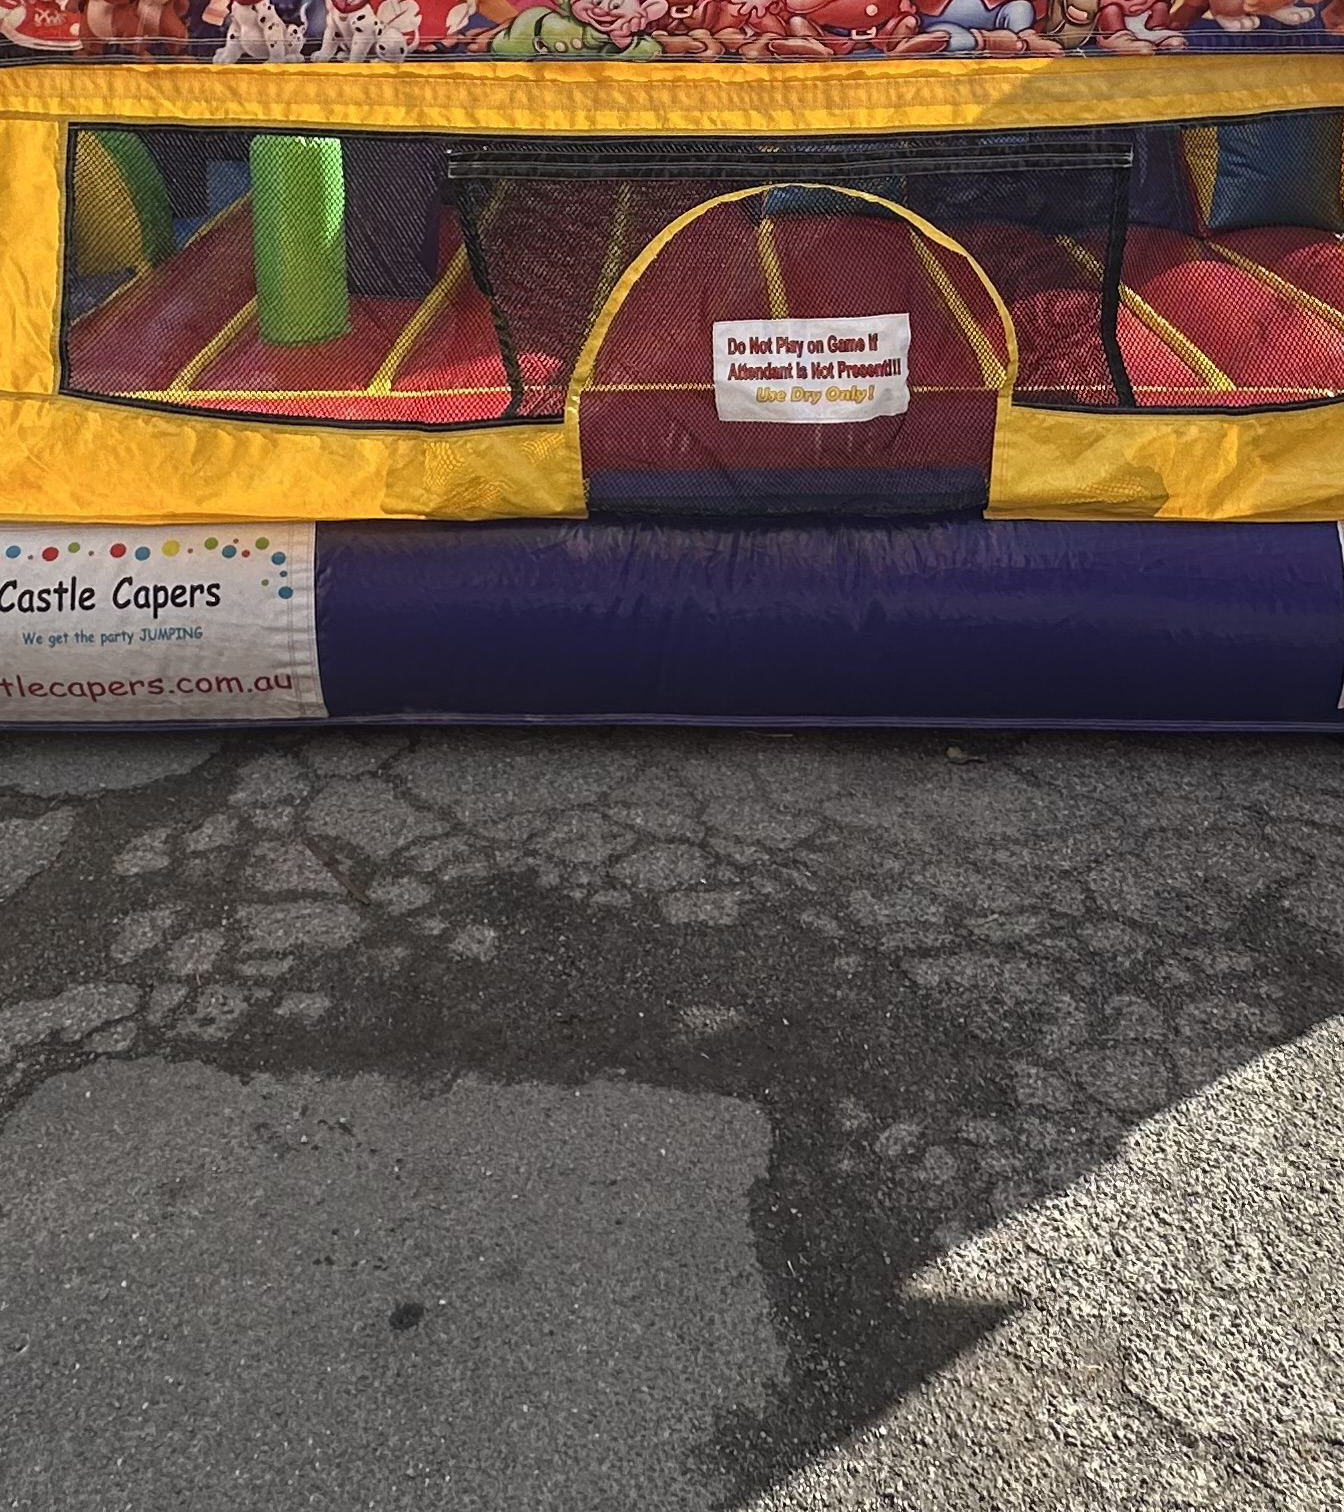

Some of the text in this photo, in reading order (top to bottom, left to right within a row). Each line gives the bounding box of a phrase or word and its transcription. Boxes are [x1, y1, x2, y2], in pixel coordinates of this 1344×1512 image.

[727, 337, 746, 356] Do
[749, 337, 773, 355] Not
[775, 336, 804, 359] Play
[807, 339, 824, 355] on
[827, 335, 865, 354] Game
[727, 358, 902, 381] Attendant Is Not Present!!!
[756, 385, 876, 405] Use Dry Only!
[112, 576, 222, 619] Capers
[22, 626, 204, 648] We get the party JUMPING
